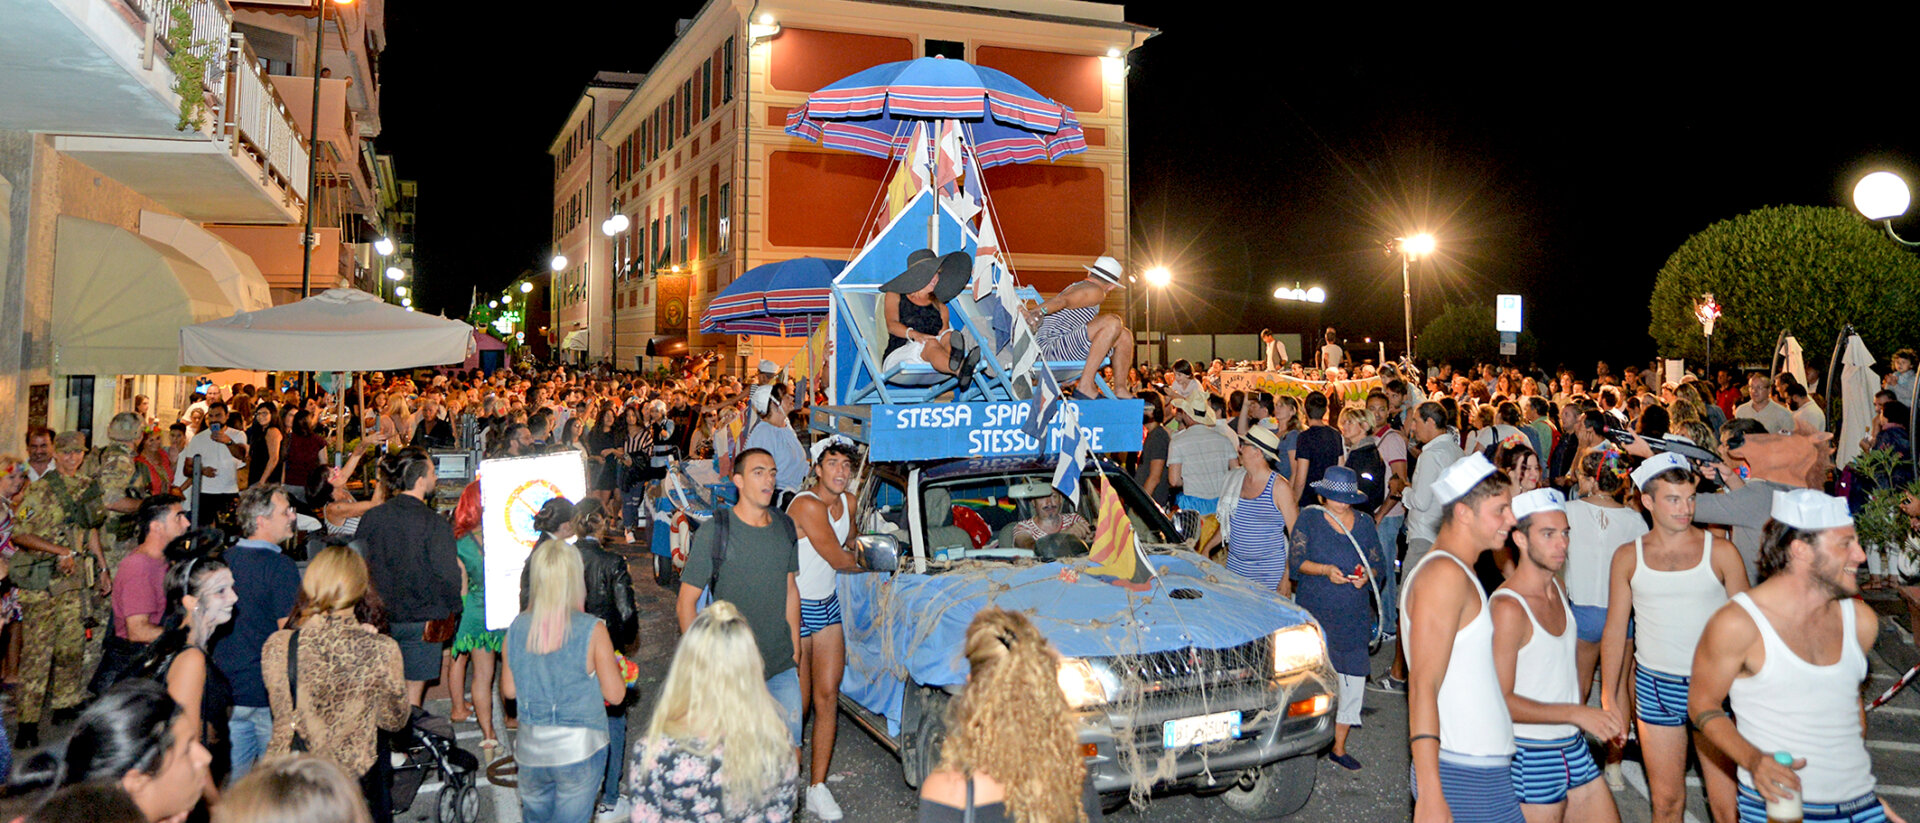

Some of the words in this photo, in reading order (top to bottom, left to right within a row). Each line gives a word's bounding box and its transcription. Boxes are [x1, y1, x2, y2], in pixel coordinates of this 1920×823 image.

[897, 404, 972, 429] STESSA
[982, 402, 1080, 427] SPIAIA
[1051, 427, 1104, 451] MRE
